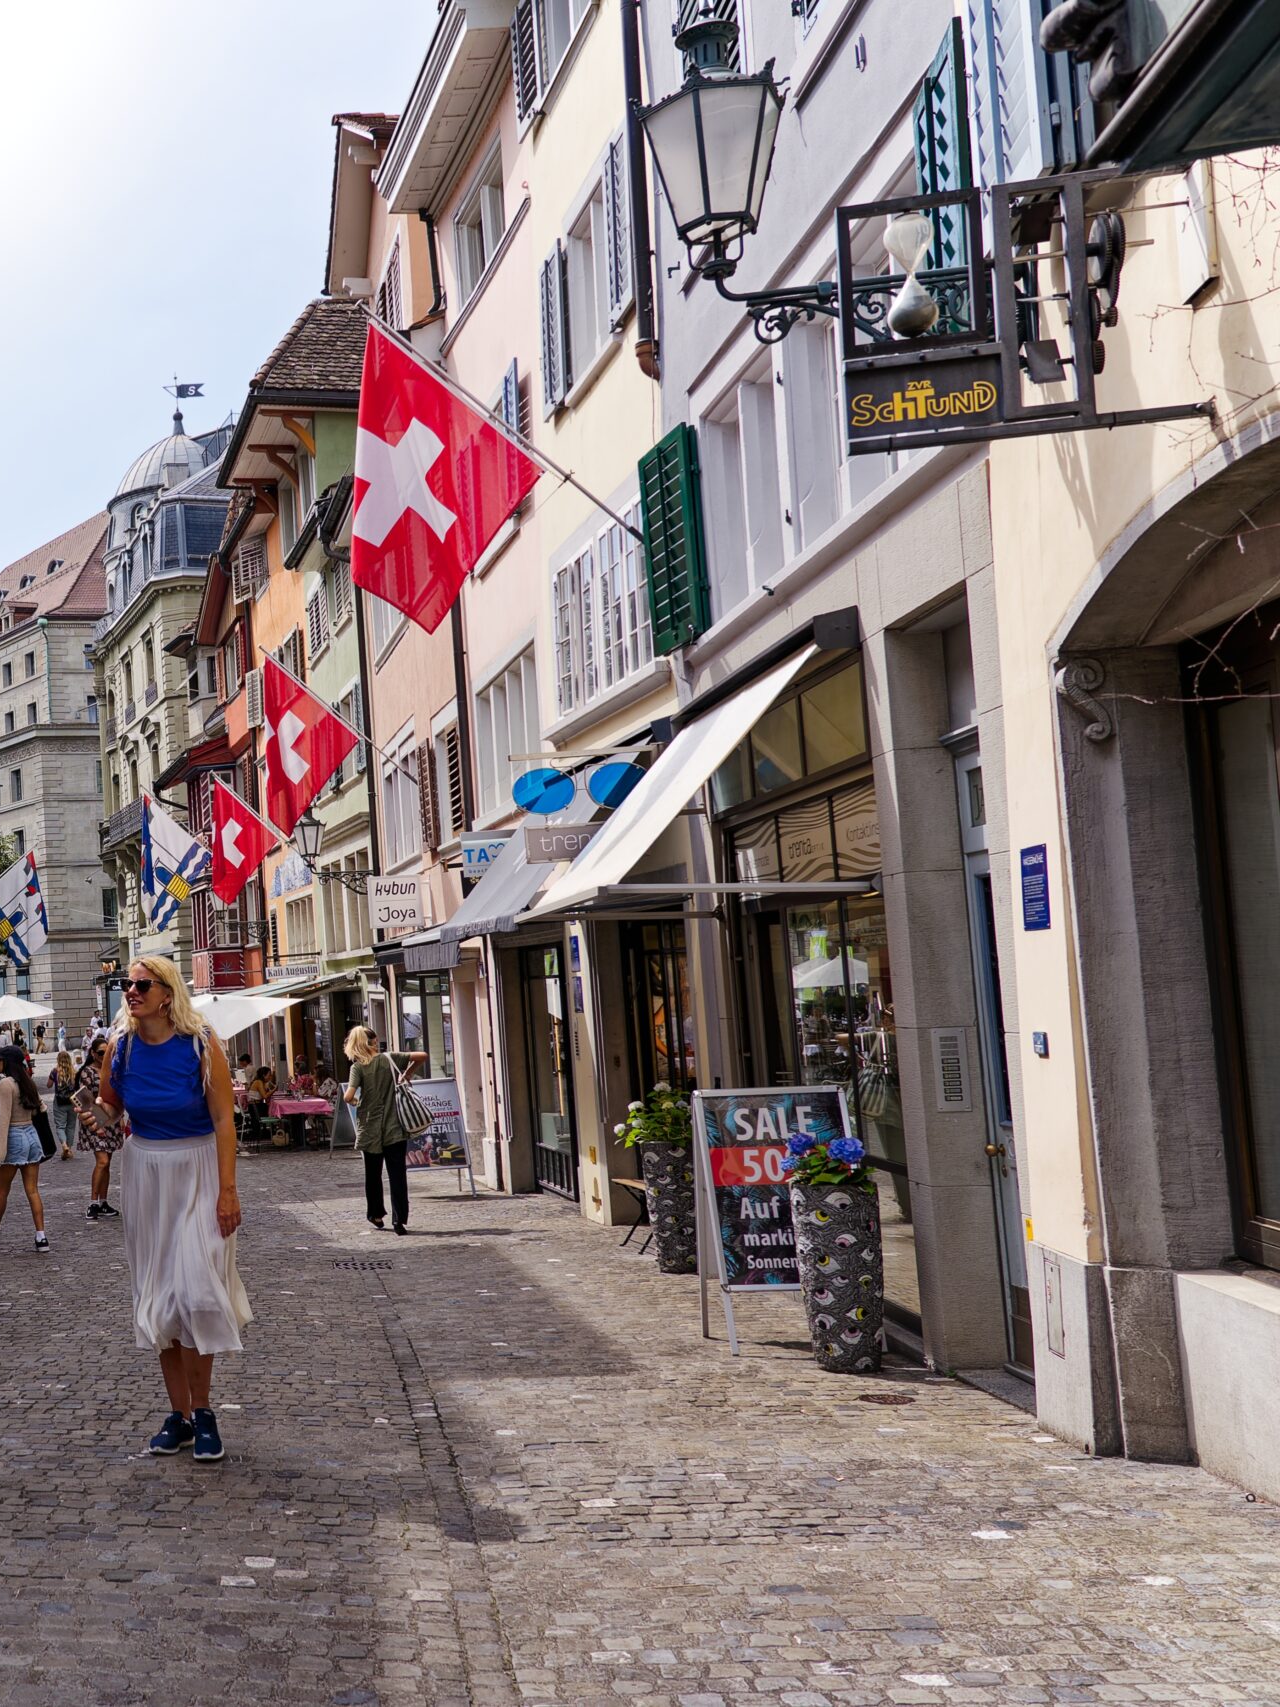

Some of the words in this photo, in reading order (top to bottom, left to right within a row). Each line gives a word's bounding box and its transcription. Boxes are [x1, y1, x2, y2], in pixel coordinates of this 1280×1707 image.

[375, 880, 416, 896] kybun
[285, 964, 318, 976] Augustin
[733, 1105, 817, 1141] SALE
[740, 1196, 780, 1219] Auf
